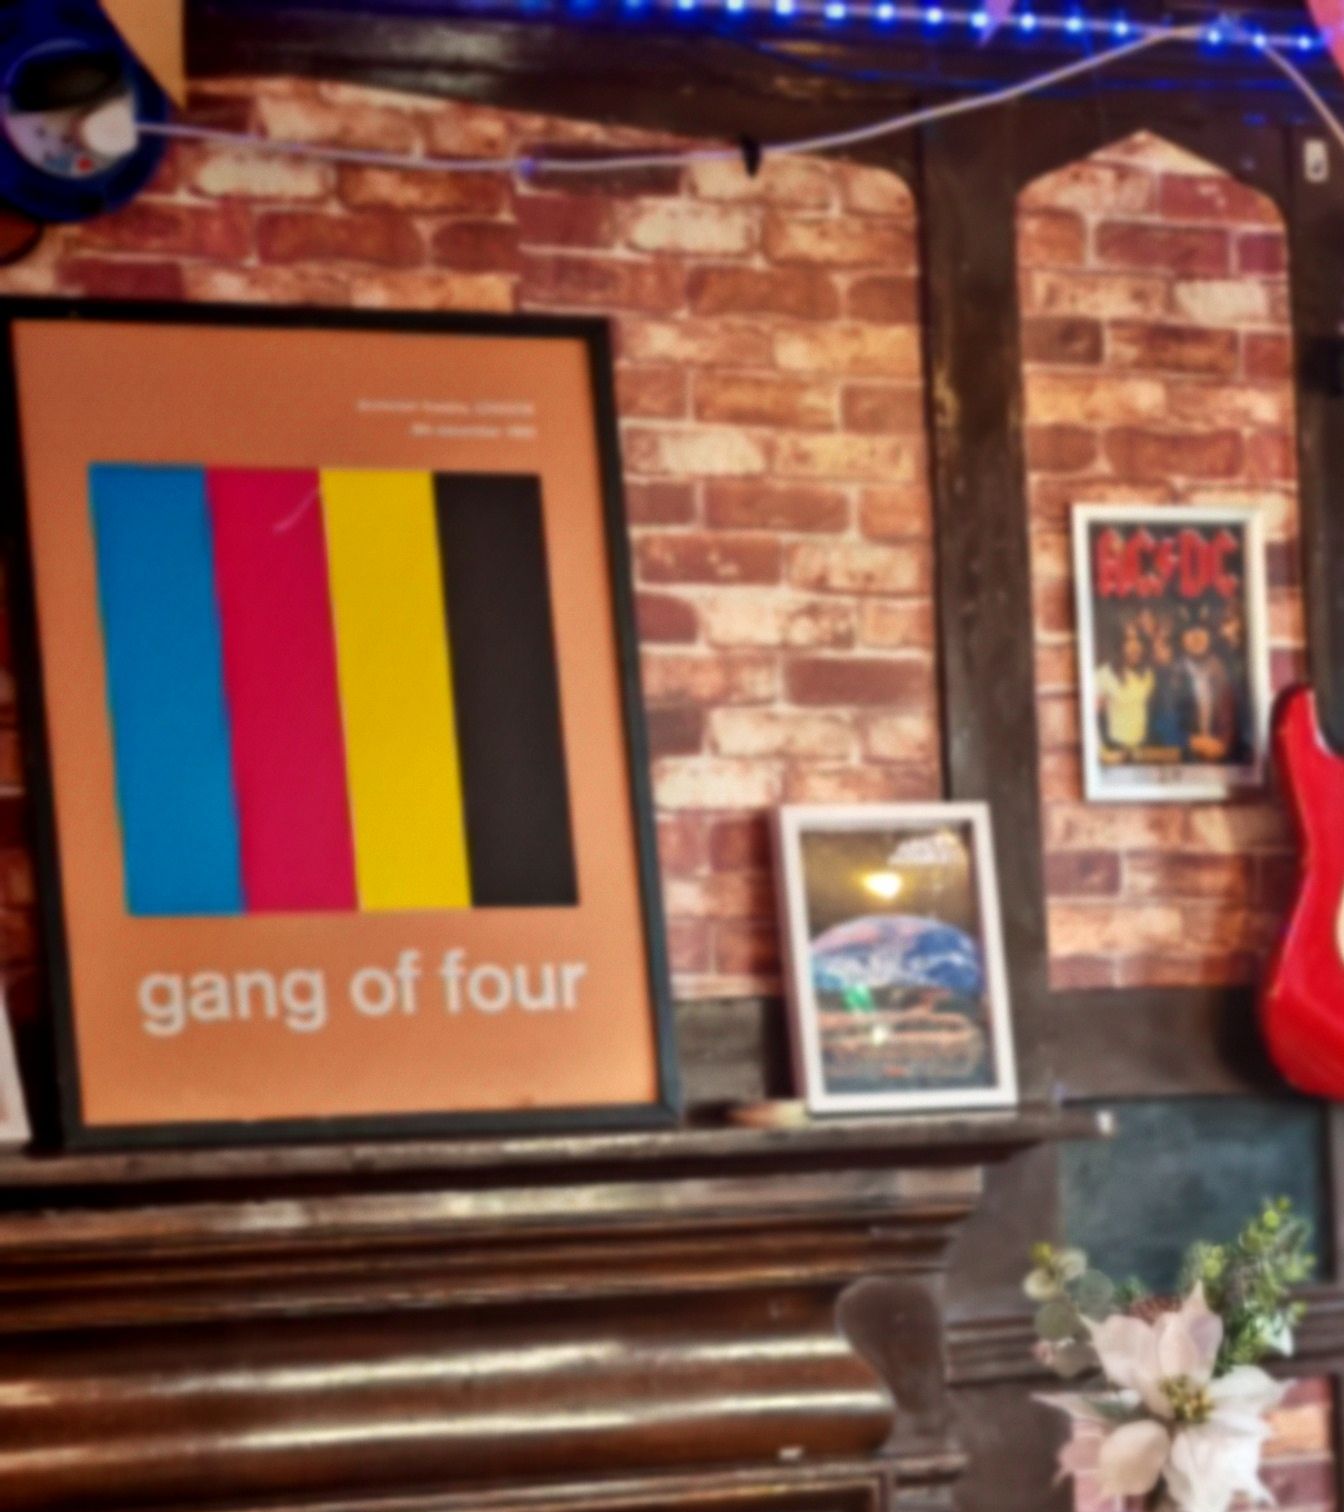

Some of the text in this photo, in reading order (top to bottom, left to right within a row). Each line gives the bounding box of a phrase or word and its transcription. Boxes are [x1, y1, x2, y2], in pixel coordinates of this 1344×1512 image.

[137, 947, 588, 1037] gang of four
